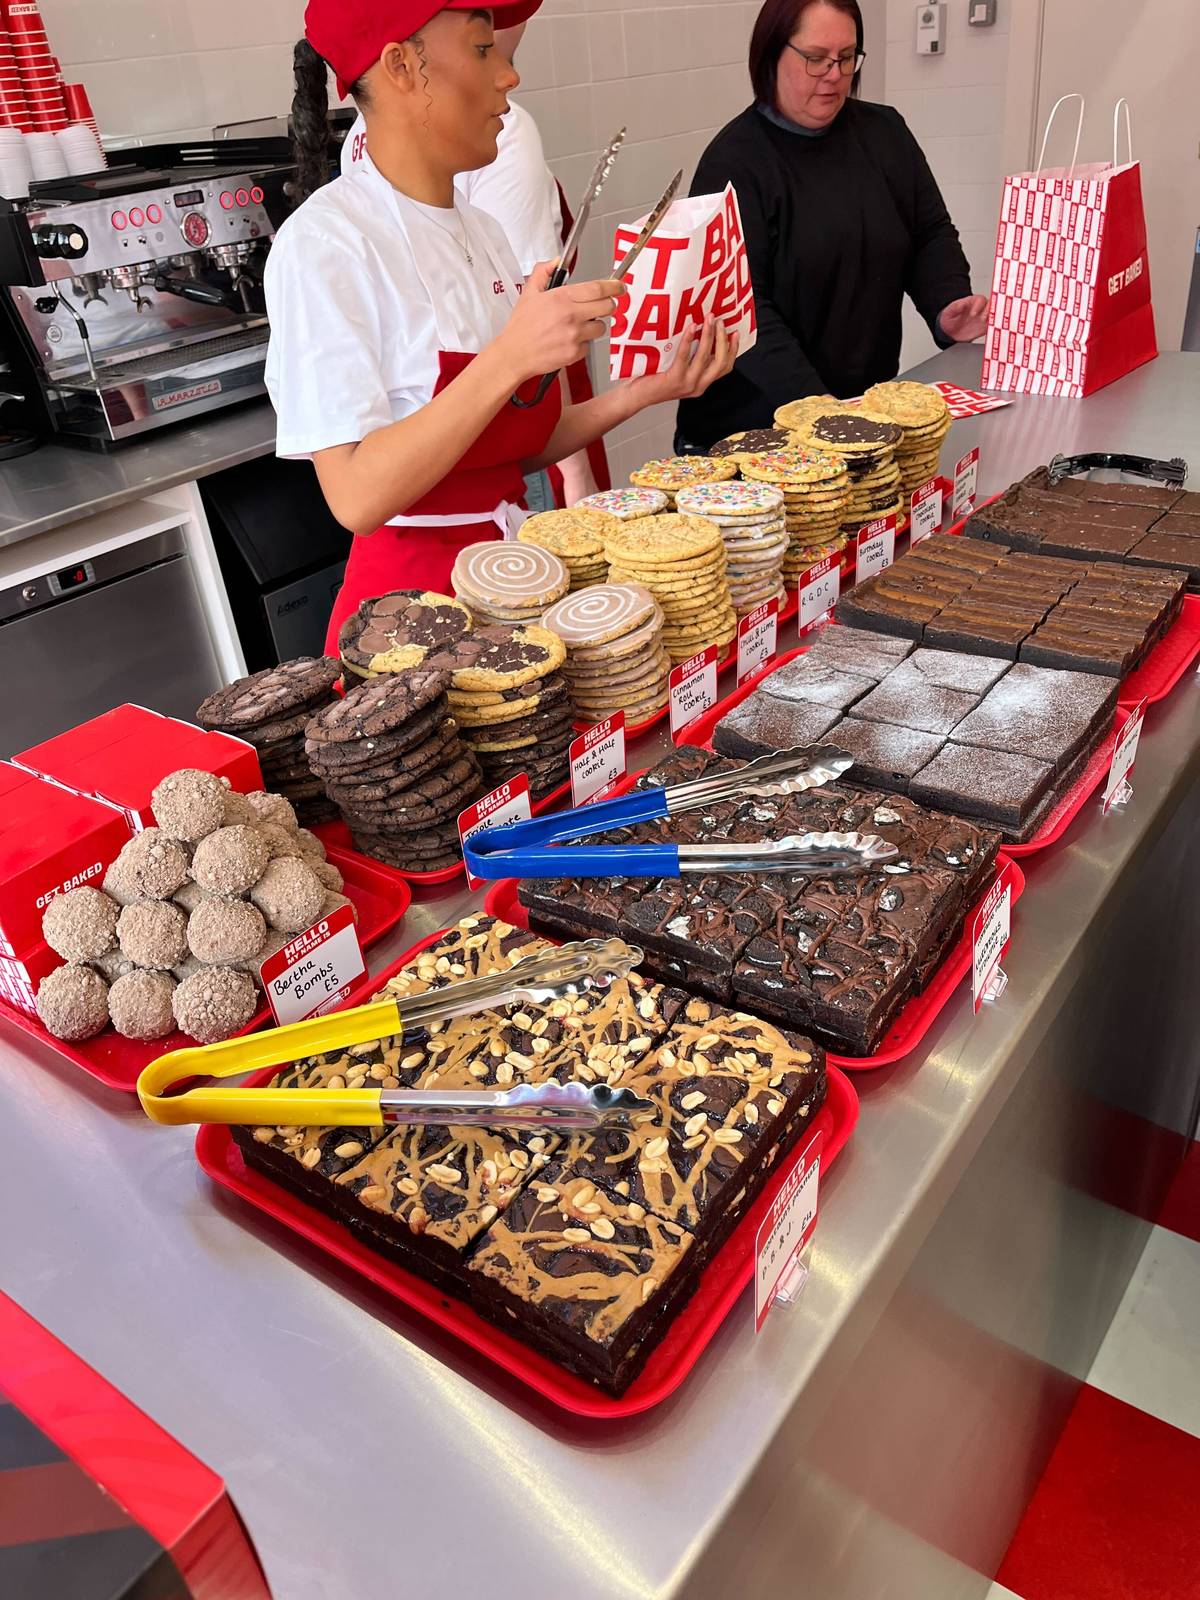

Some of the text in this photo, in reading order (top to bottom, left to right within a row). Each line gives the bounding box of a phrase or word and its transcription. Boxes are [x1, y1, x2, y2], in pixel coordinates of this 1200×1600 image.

[614, 229, 690, 289] ET
[1108, 270, 1124, 296] GET
[868, 519, 886, 534] HELLO
[810, 558, 830, 577] HELLO
[748, 604, 768, 623] HELLO
[682, 652, 705, 674] HELLO
[703, 697, 711, 708] £3
[584, 720, 610, 744] HELLO
[592, 750, 597, 758] &
[609, 768, 617, 780] £3
[476, 785, 510, 813] HELLO
[478, 810, 488, 820] MY
[36, 862, 102, 908] GET BAKED
[284, 921, 328, 958] HELLO
[288, 931, 331, 966] MY NAME IS
[274, 961, 316, 995] Bertha
[294, 963, 333, 999] Bombs
[324, 974, 339, 992] £5
[773, 1158, 806, 1214] HELLO
[801, 1211, 812, 1232] £4
